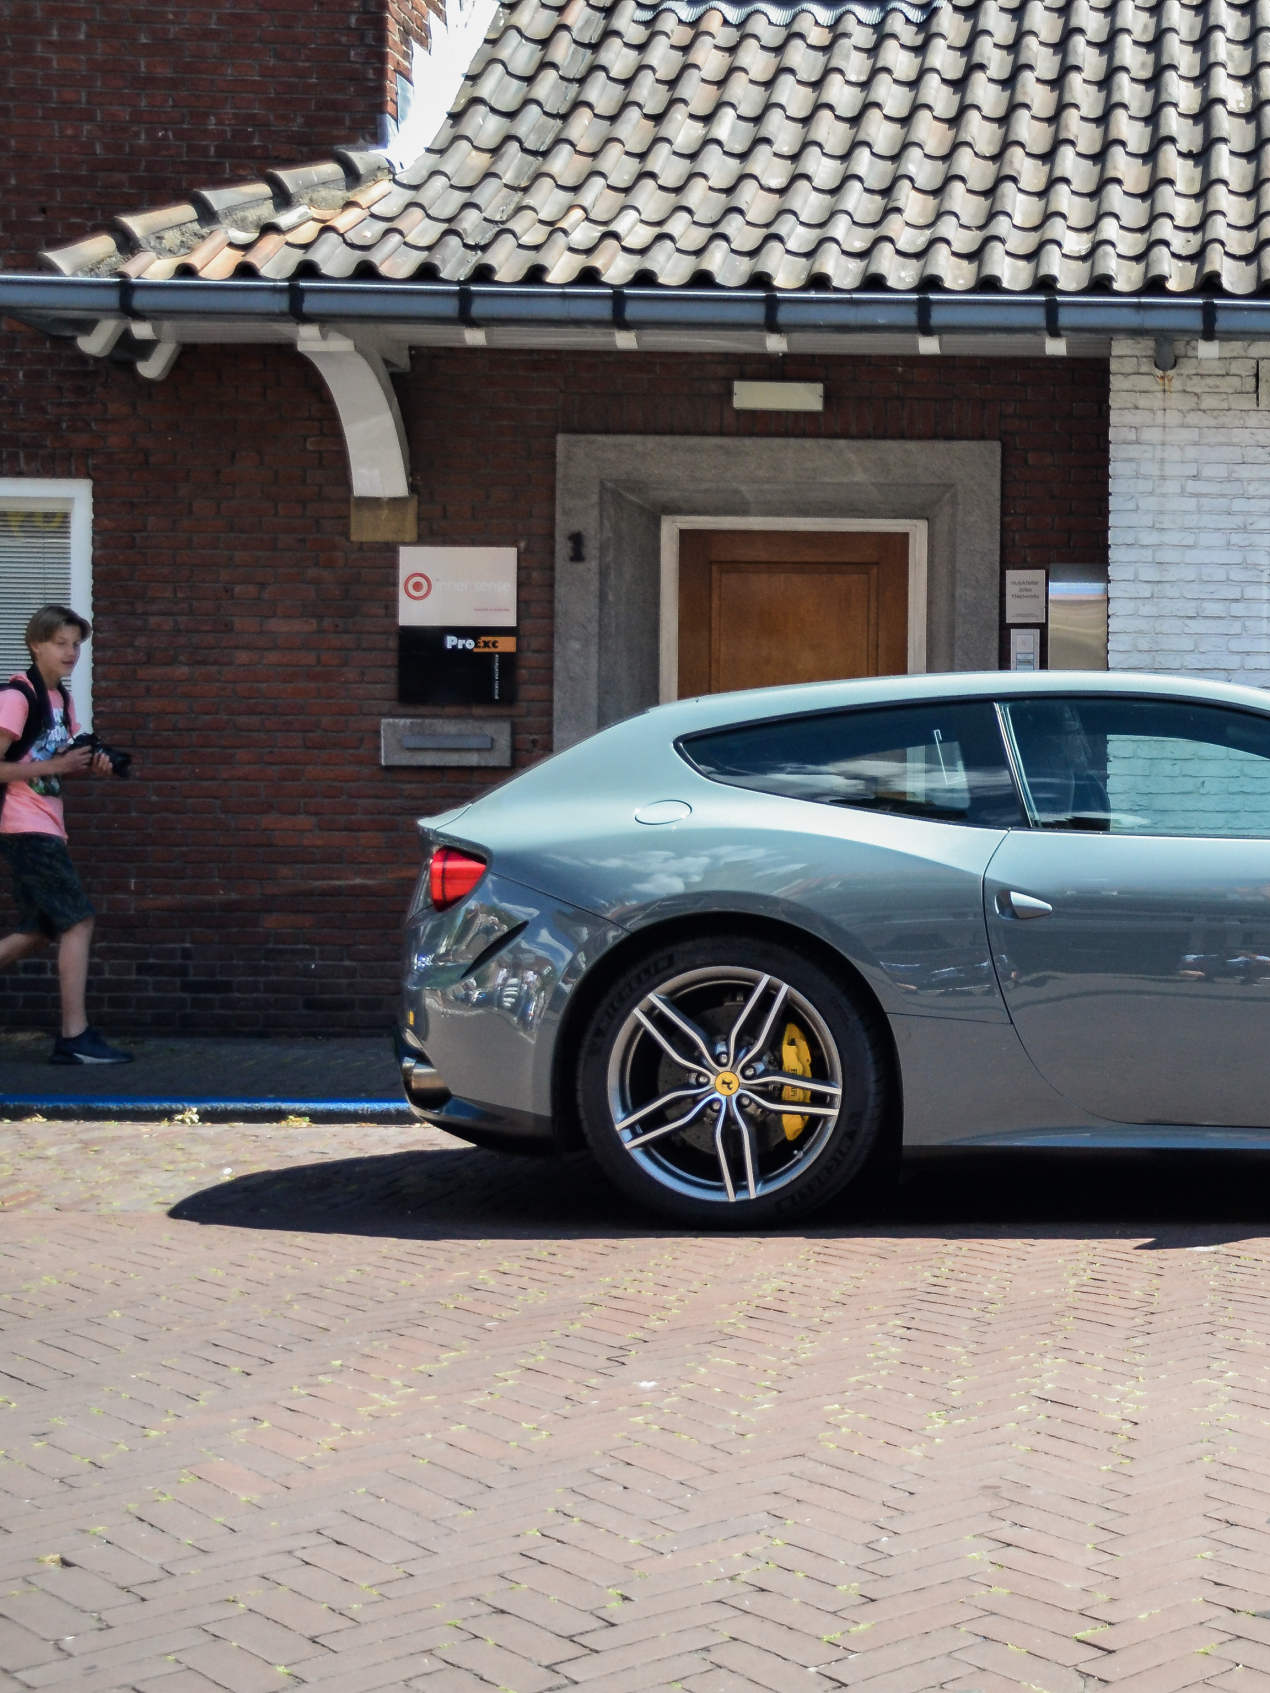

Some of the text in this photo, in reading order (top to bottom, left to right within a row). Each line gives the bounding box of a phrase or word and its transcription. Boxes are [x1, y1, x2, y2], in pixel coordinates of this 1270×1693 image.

[436, 580, 511, 592] inner sense
[599, 955, 672, 1031] MICHELIN
